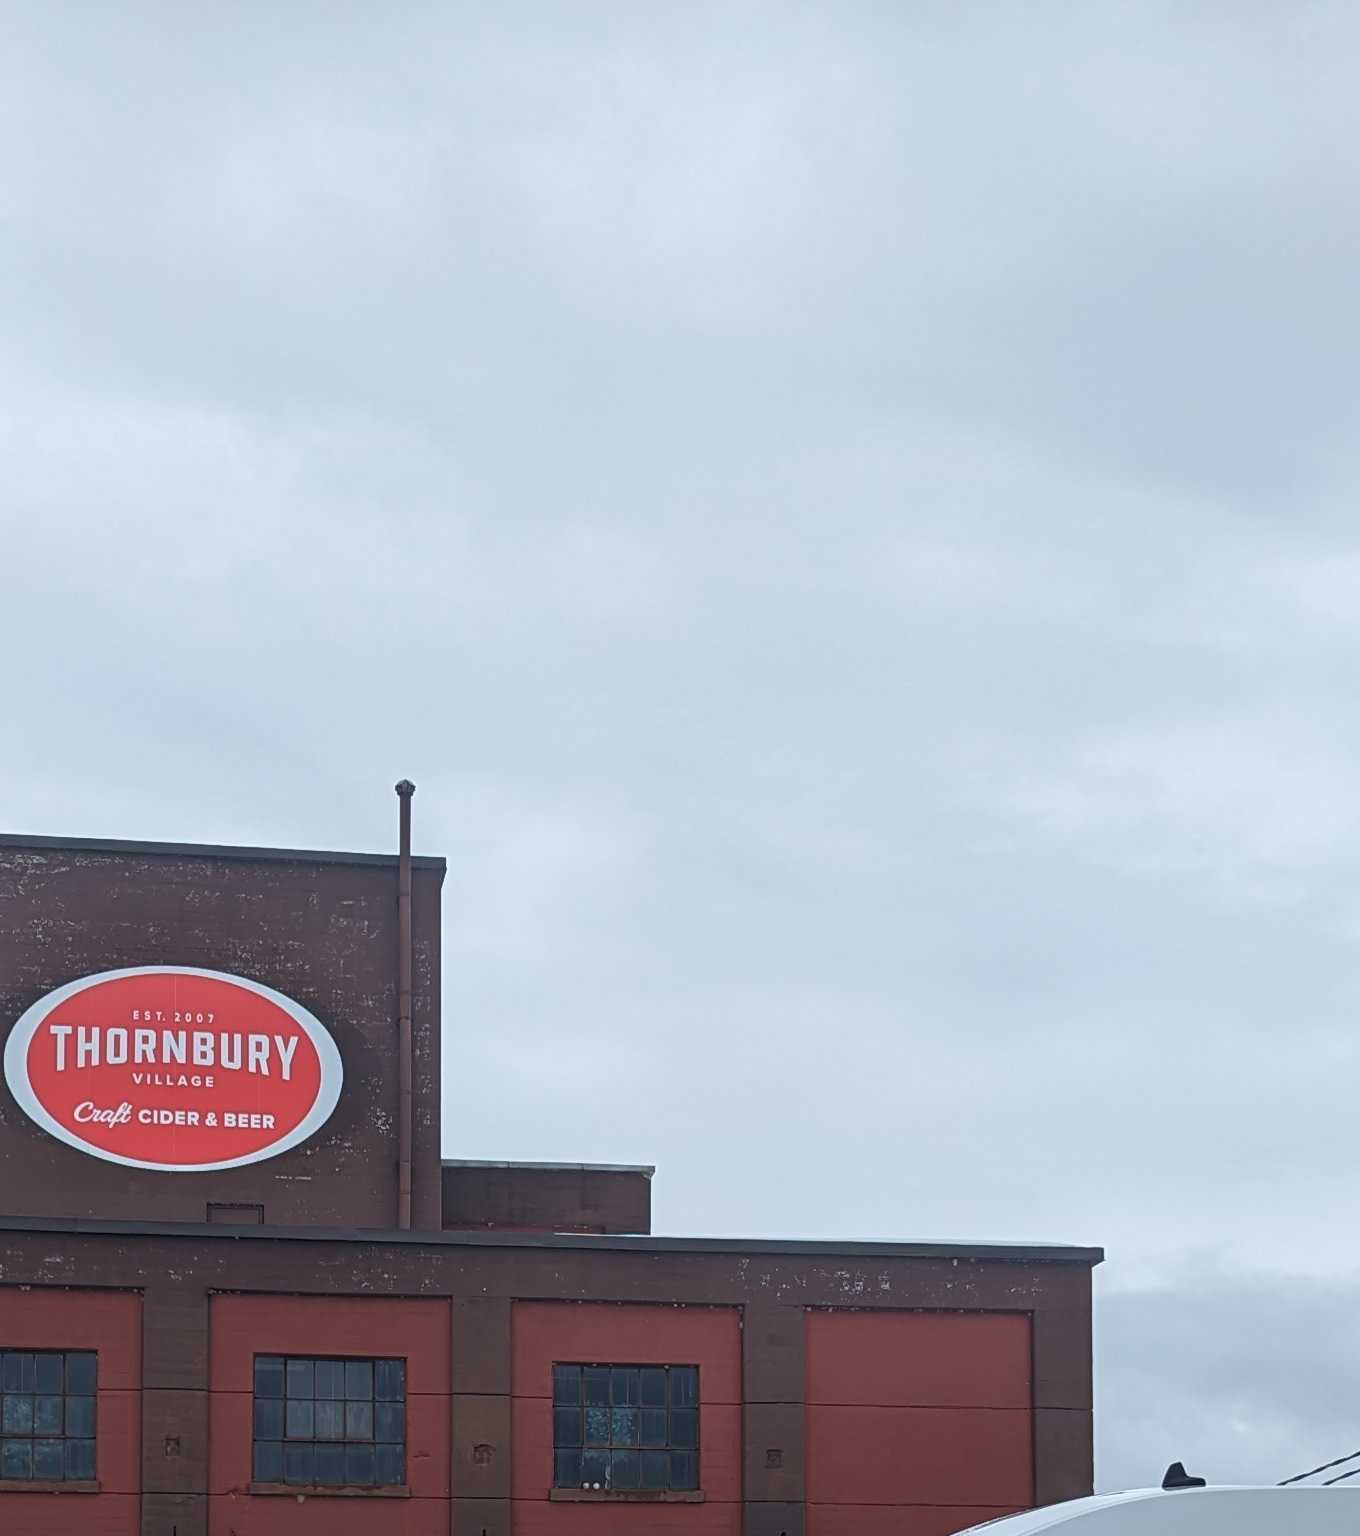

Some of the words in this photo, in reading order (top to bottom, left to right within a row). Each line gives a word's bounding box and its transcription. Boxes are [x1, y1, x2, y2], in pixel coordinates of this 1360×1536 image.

[132, 1010, 167, 1022] EST.
[174, 1012, 216, 1024] 2007
[49, 1024, 299, 1081] THORNBURY
[132, 1073, 216, 1088] VILLAGE
[73, 1101, 132, 1129] Craft
[137, 1109, 200, 1127] CIDER
[205, 1112, 218, 1127] &
[223, 1112, 275, 1129] BEER
